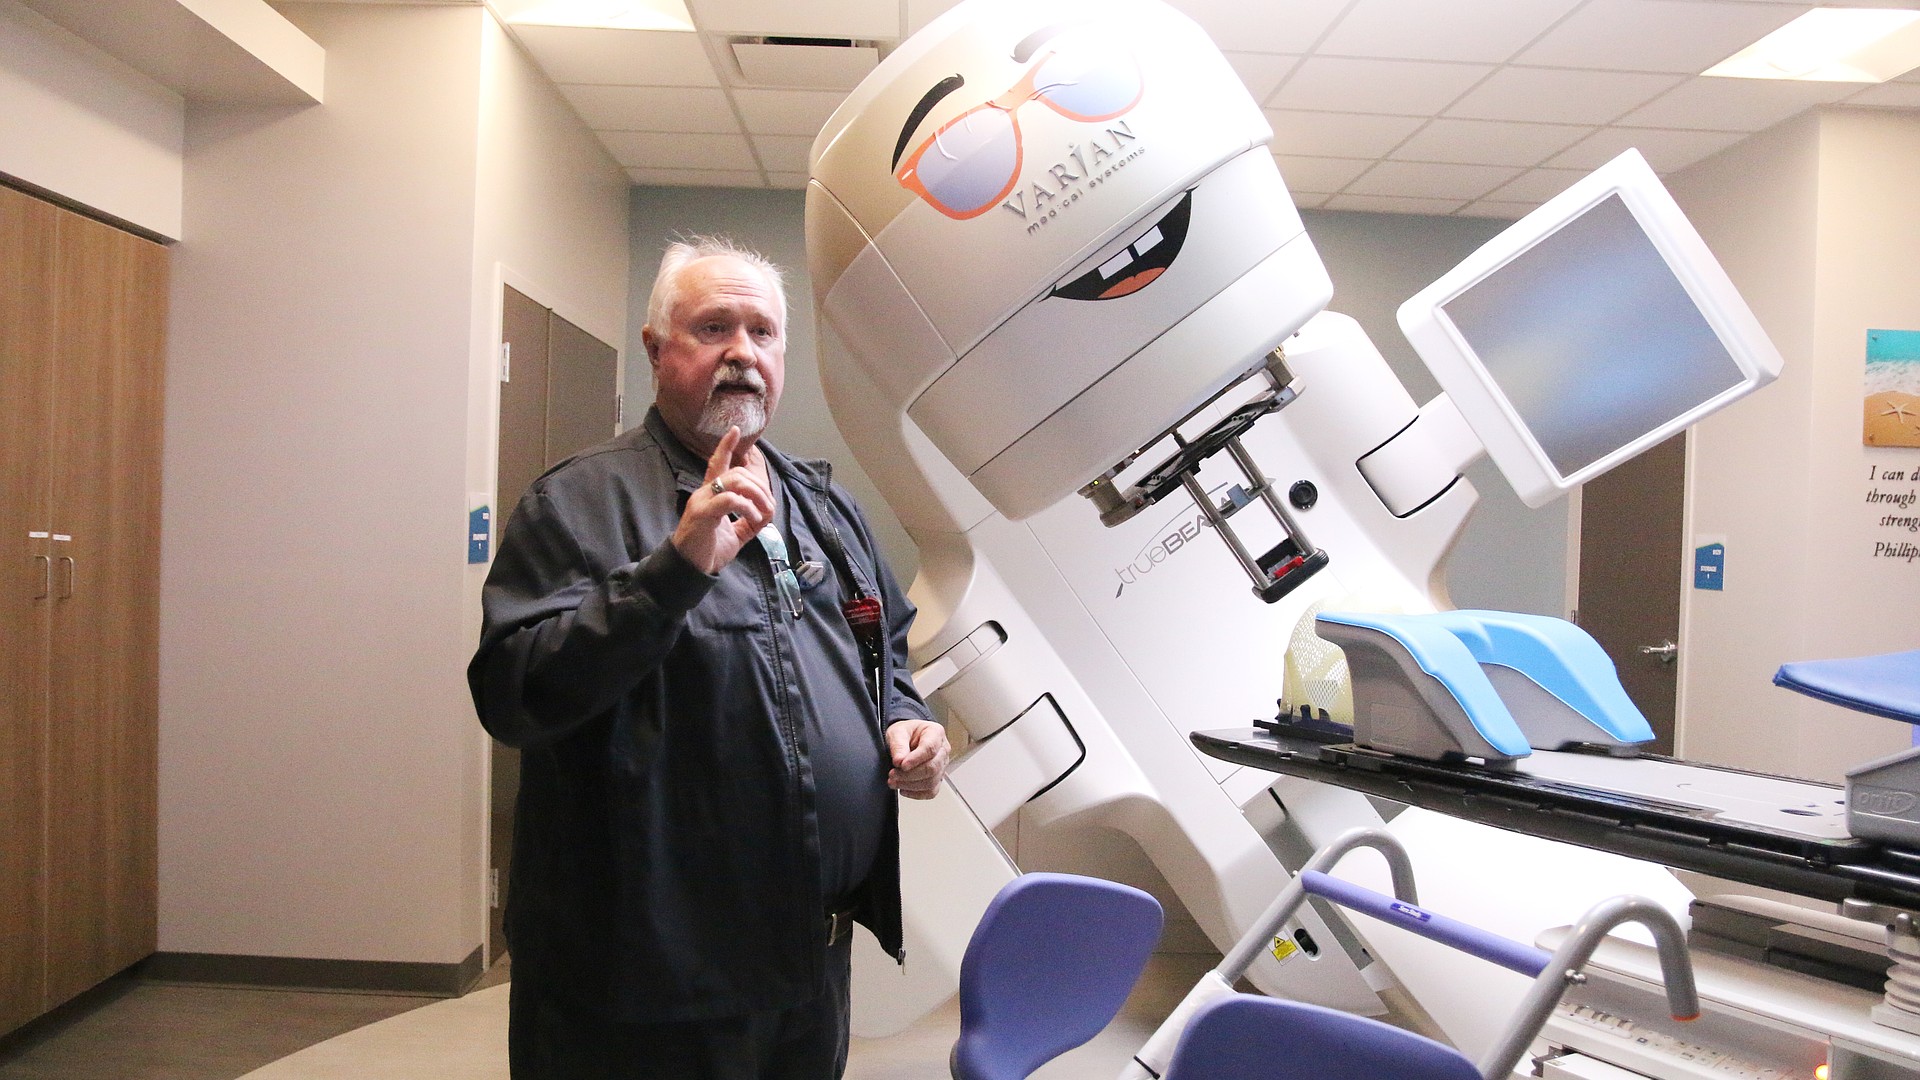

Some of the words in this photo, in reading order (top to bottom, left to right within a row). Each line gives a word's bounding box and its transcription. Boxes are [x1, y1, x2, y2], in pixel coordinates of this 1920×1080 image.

[1089, 146, 1146, 188] systems
[1869, 465, 1876, 480] I
[1882, 469, 1905, 481] can
[1911, 465, 1920, 481] d
[1866, 488, 1917, 509] through
[1879, 514, 1920, 532] streng
[1114, 497, 1228, 585] trueBEA
[1874, 541, 1920, 563] Phillip
